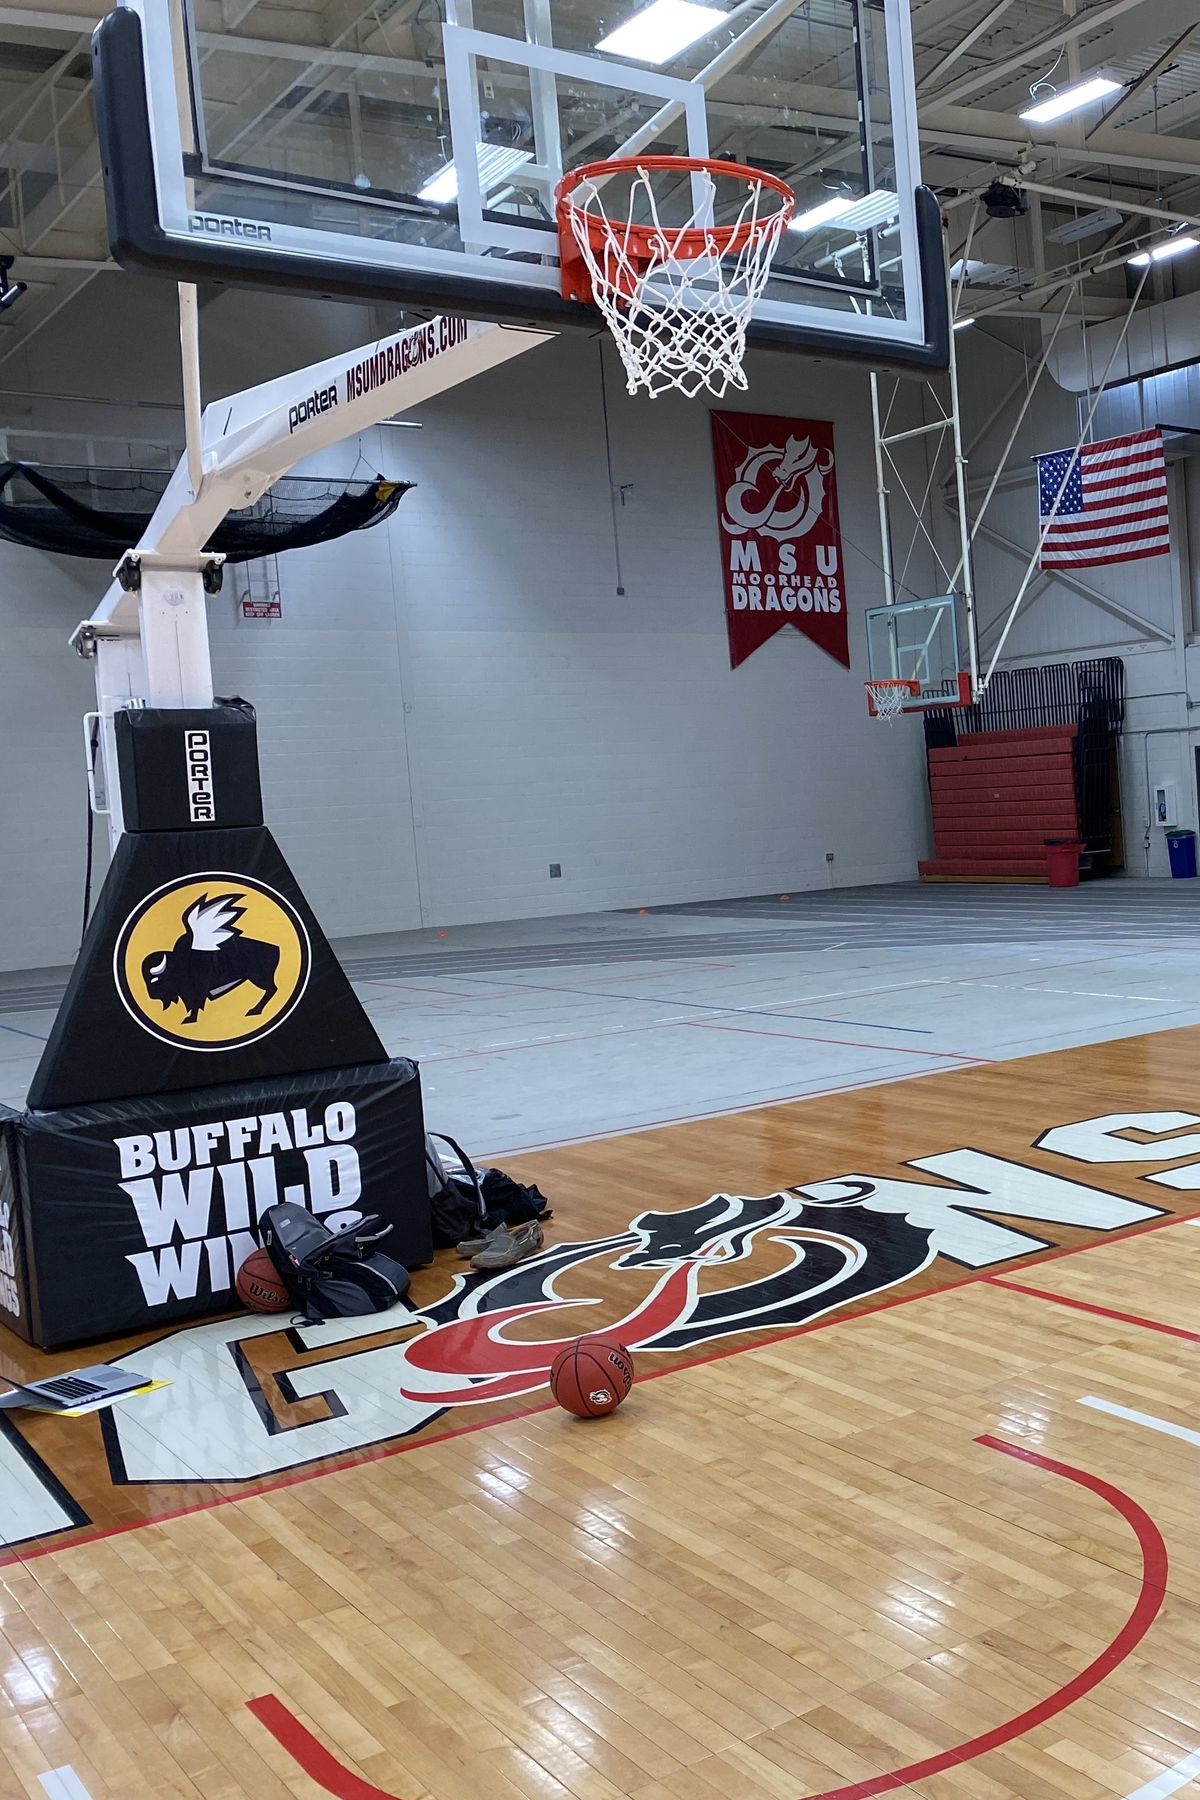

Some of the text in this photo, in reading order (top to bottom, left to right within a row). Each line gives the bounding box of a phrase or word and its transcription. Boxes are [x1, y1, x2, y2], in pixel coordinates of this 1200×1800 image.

[731, 585, 841, 613] DRAGONS
[732, 572, 837, 588] MOORHEAD
[113, 1101, 356, 1180] BUFFALO
[118, 1143, 363, 1248] WILD
[125, 1210, 364, 1307] WIN
[250, 1282, 289, 1304] Wilso
